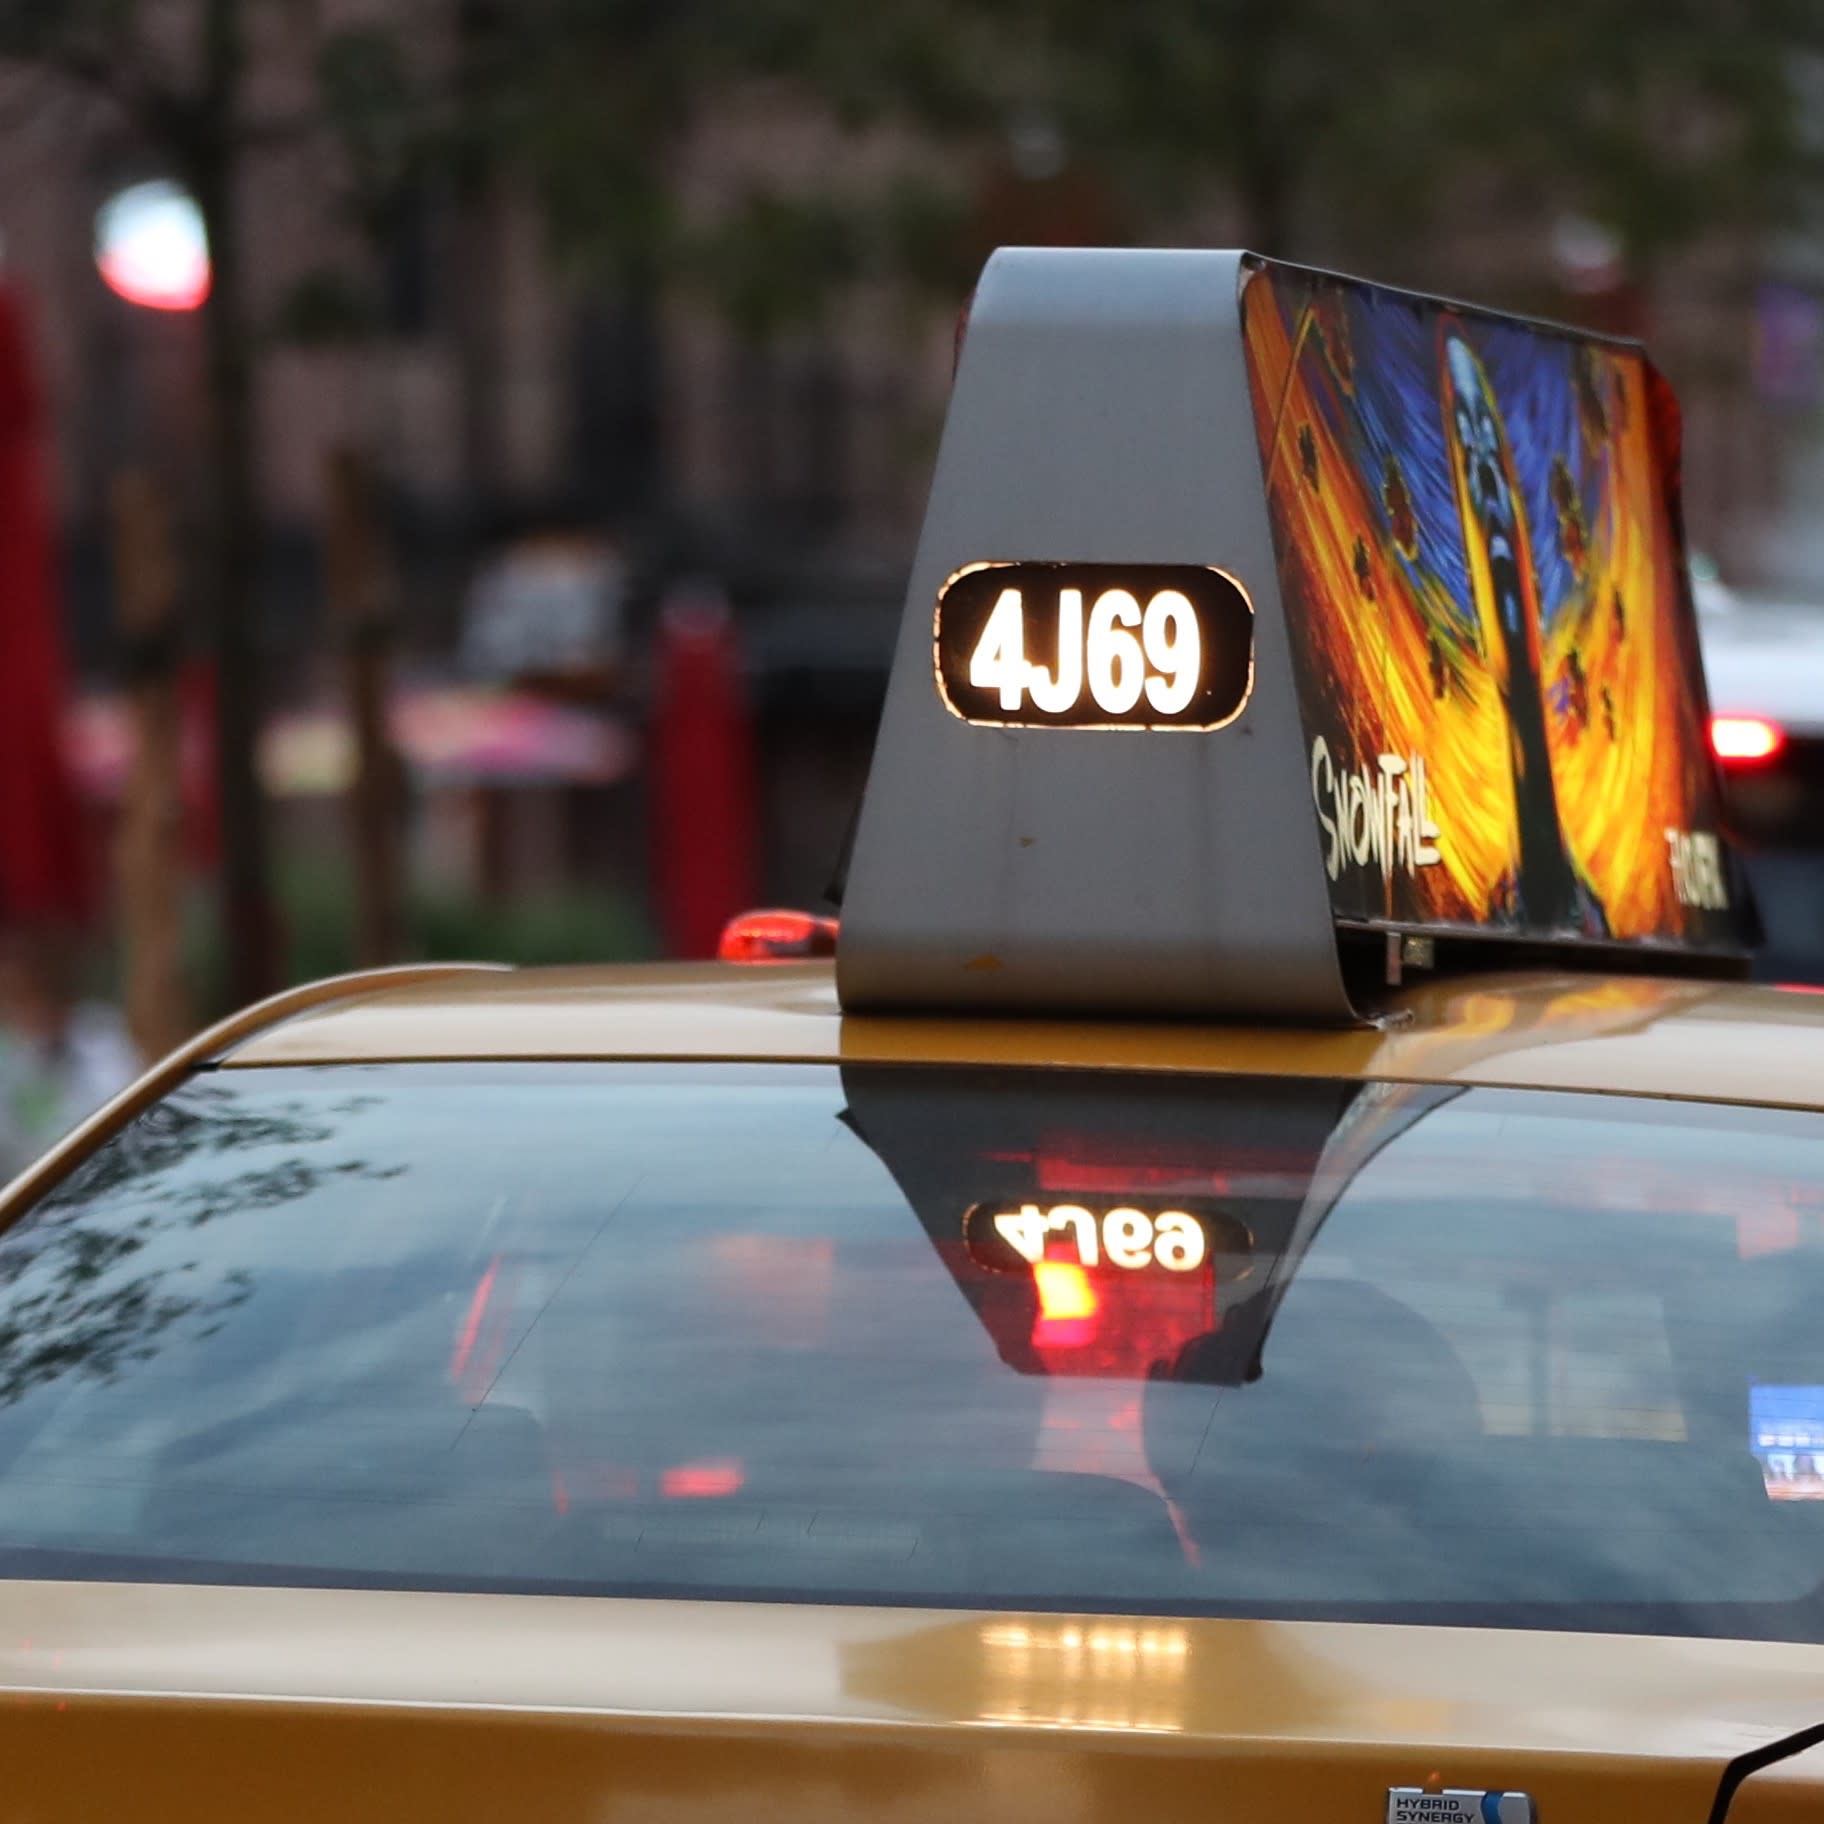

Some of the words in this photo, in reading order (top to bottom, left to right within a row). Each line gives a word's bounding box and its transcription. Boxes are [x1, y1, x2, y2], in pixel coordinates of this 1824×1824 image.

[969, 587, 1202, 715] 4J69
[1312, 735, 1441, 882] SNOWFALL
[1396, 1798, 1459, 1811] HYBRID
[1396, 1811, 1474, 1824] SYNERGY
